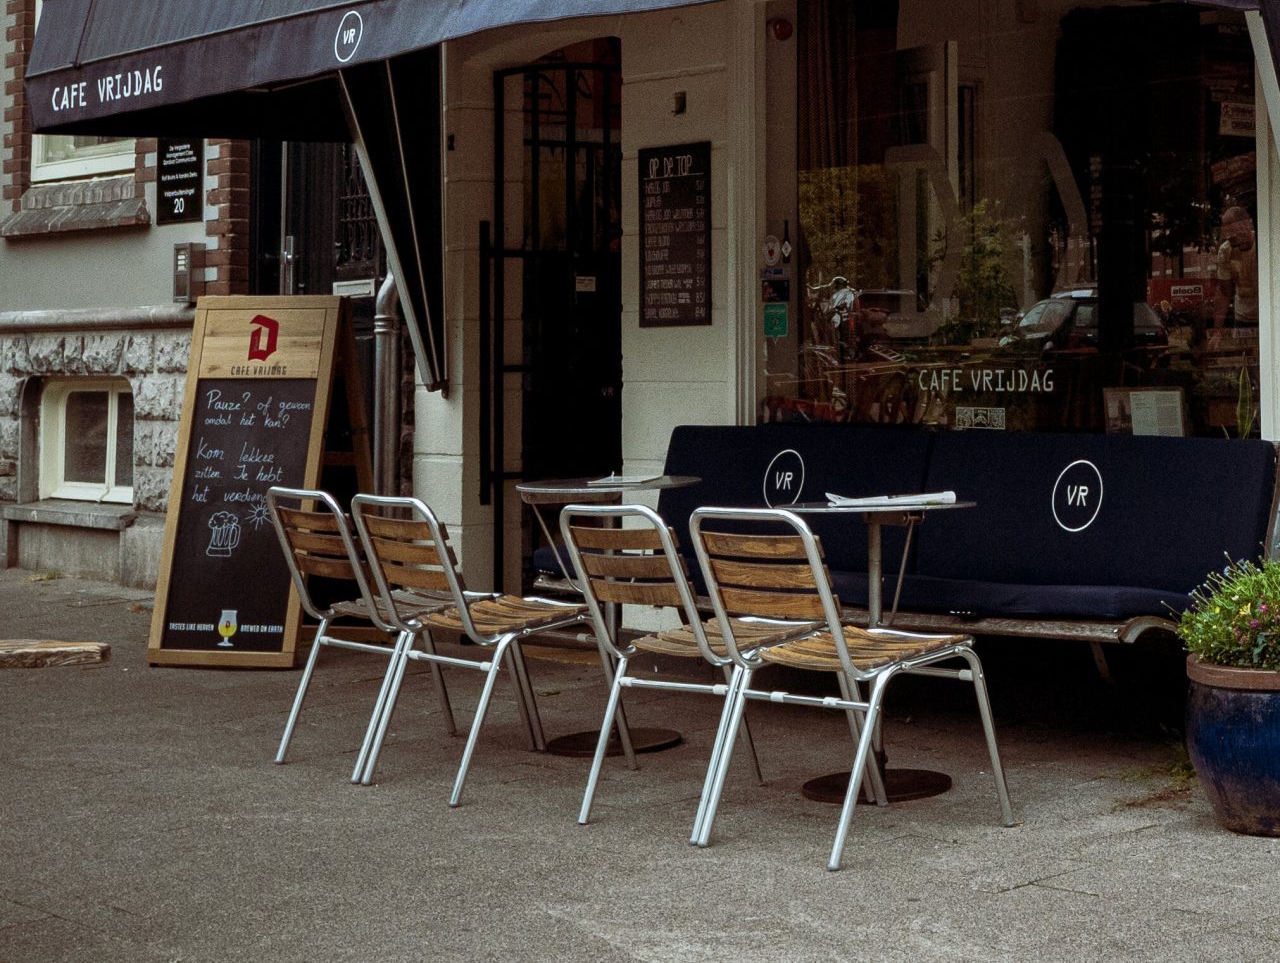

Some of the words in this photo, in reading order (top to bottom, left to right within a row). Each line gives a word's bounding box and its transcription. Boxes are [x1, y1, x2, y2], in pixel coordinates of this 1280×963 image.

[343, 28, 356, 45] VR
[51, 82, 87, 111] CAFE
[98, 66, 163, 102] VRIJDAG
[174, 197, 185, 214] 20
[248, 314, 280, 361] D
[231, 366, 249, 375] CAFE
[253, 365, 287, 375] VRIJDAG
[918, 369, 963, 392] CAFE
[971, 369, 1054, 392] VRIJDAG
[206, 389, 251, 411] Pauze?
[257, 396, 272, 415] of
[240, 413, 256, 426] het
[264, 415, 290, 429] kan?
[775, 472, 793, 491] VR
[191, 484, 210, 503] het
[1067, 485, 1088, 507] VR
